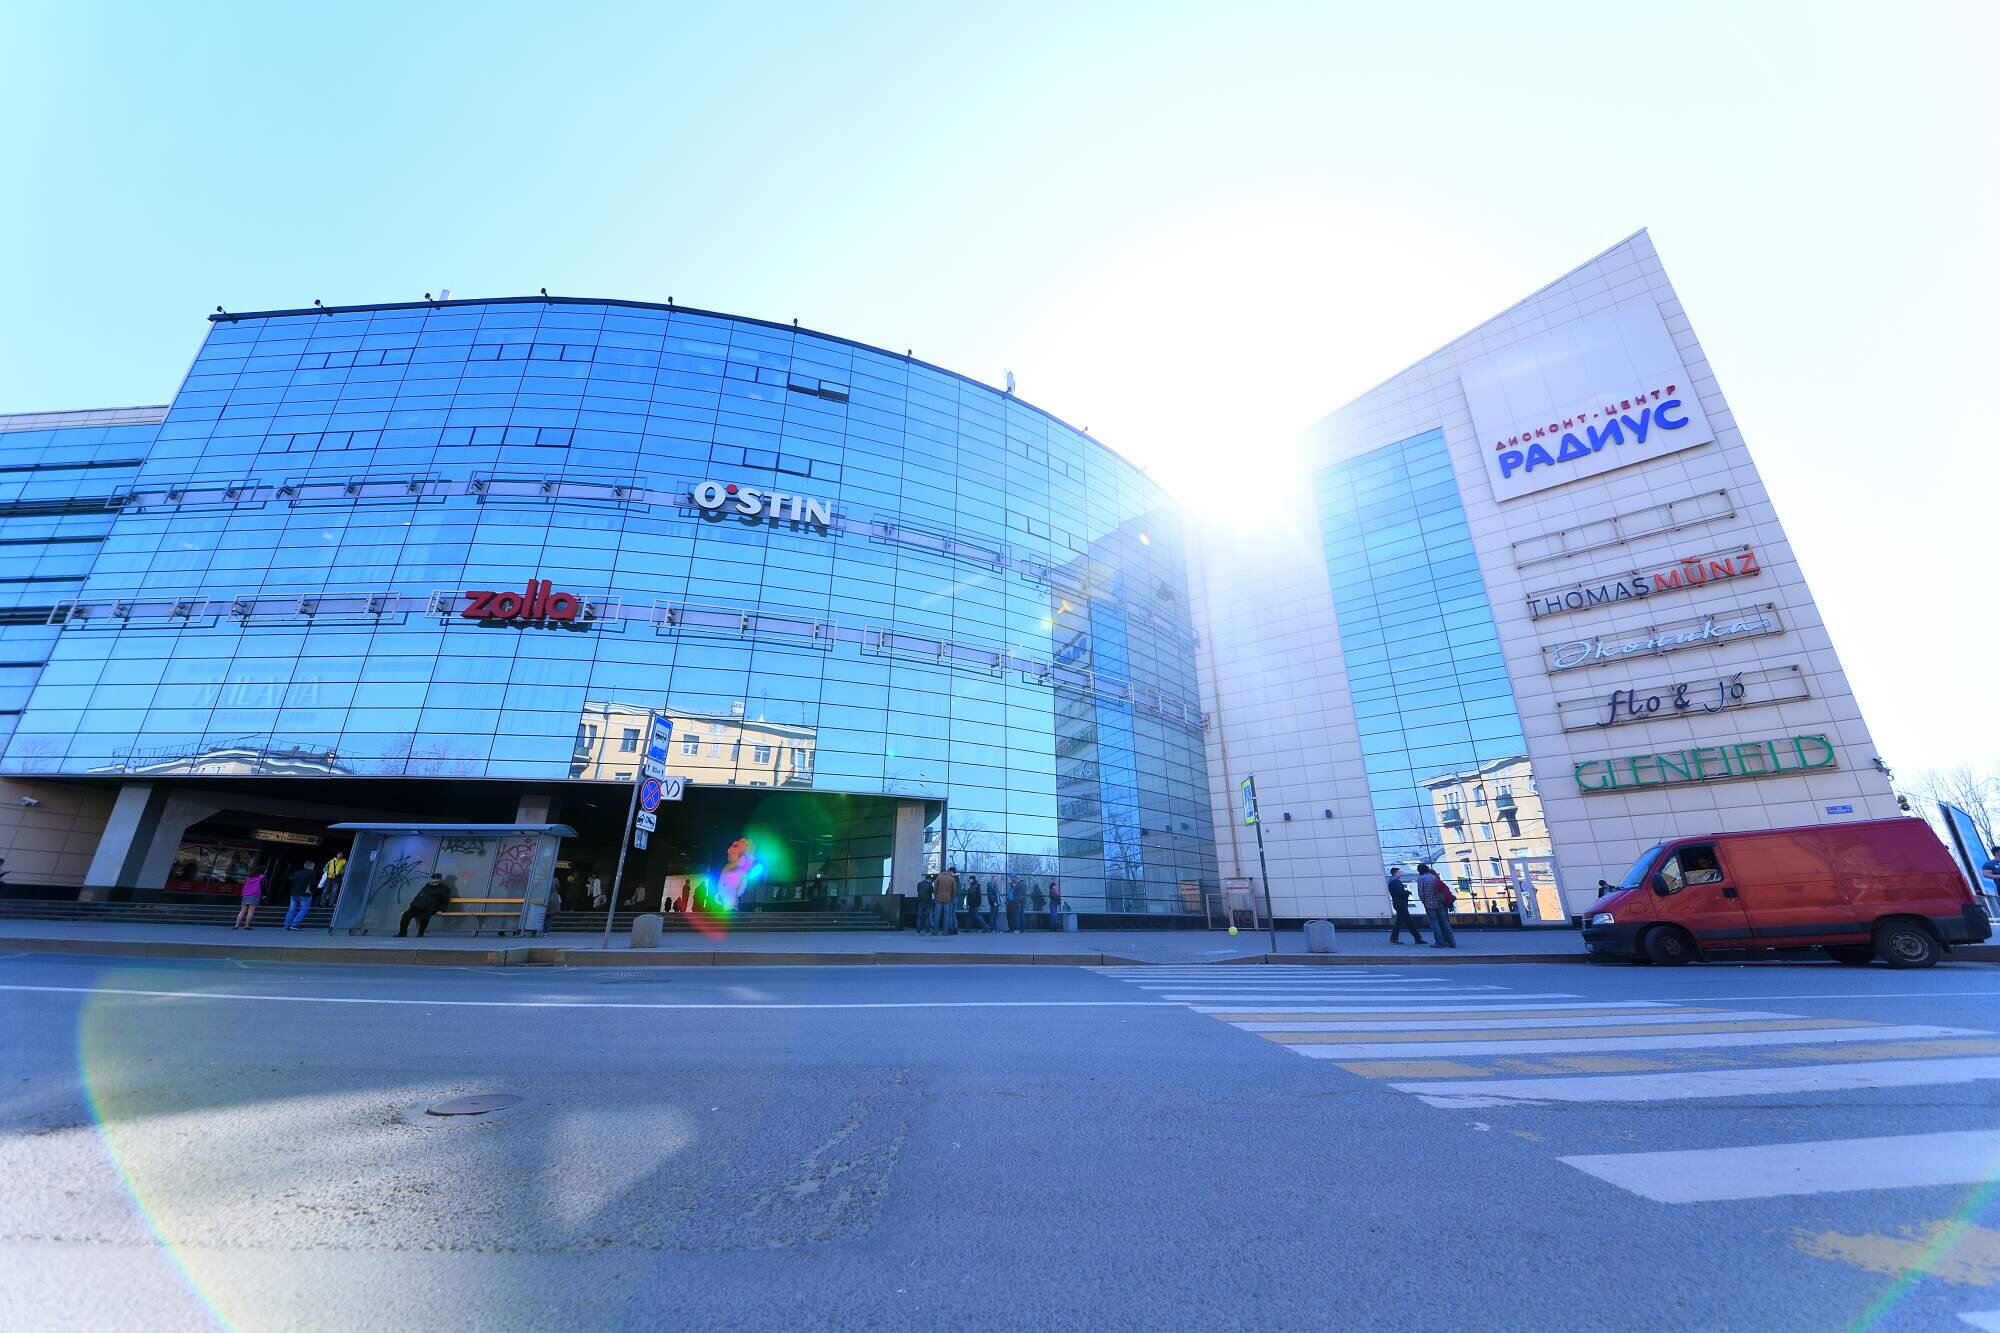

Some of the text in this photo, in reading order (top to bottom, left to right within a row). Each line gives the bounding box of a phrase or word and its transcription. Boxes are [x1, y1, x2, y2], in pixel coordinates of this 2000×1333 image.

[1498, 399, 1689, 479] РАДИУС
[460, 578, 579, 621] zolla
[1526, 577, 1650, 617] THOMAS
[1596, 689, 1661, 727] flo
[1673, 683, 1691, 710] &
[1574, 734, 1835, 792] GLENFIELD
